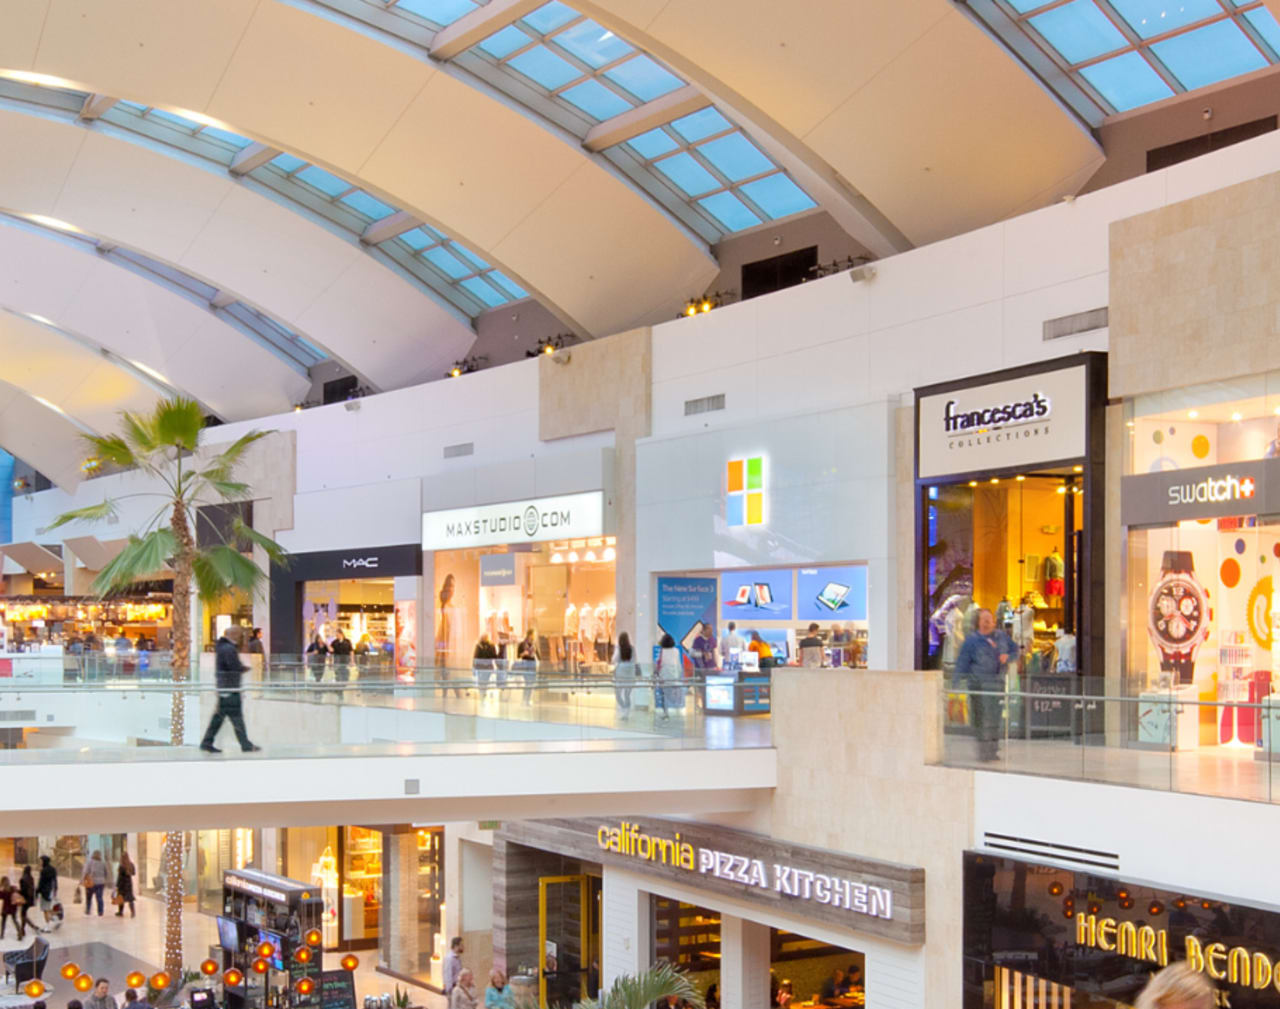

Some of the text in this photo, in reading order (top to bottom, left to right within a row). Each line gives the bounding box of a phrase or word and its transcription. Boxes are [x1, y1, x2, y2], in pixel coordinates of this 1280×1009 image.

[944, 393, 1049, 431] francesca's
[949, 426, 1049, 449] COLLECTIONS
[598, 821, 892, 919] california PIZZA KITCHEN
[1076, 912, 1168, 967] HENRI
